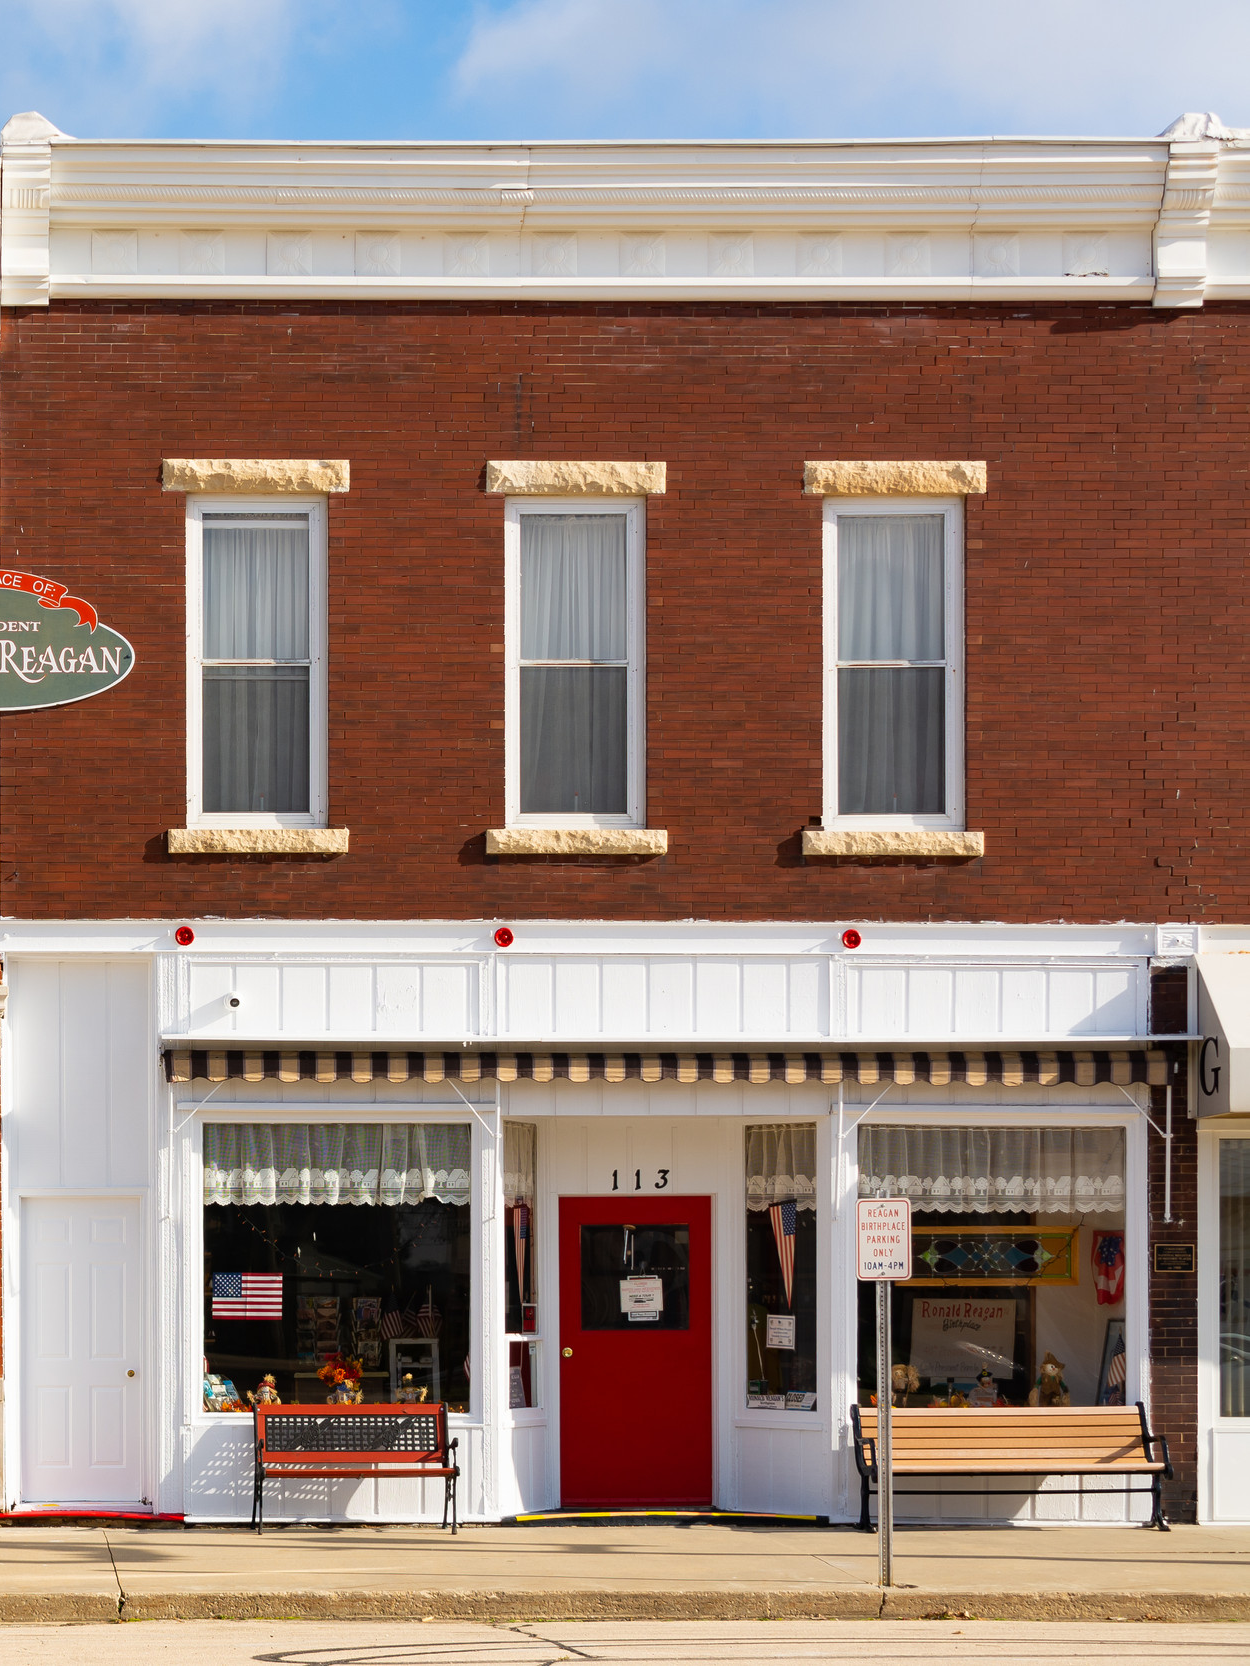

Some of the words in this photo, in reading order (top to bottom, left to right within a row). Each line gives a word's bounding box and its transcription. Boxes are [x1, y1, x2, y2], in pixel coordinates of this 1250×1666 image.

[32, 580, 56, 598] OF:
[1199, 1035, 1222, 1097] G
[867, 1208, 899, 1218] REAGAN
[861, 1221, 906, 1231] BIRTHPLACE
[866, 1235, 901, 1244] PARKING
[873, 1248, 894, 1257] ONLY
[863, 1261, 904, 1270] 10AM-4PM
[921, 1301, 961, 1318] Ronald
[964, 1302, 1003, 1321] Reagan
[942, 1318, 982, 1332] Birthplace
